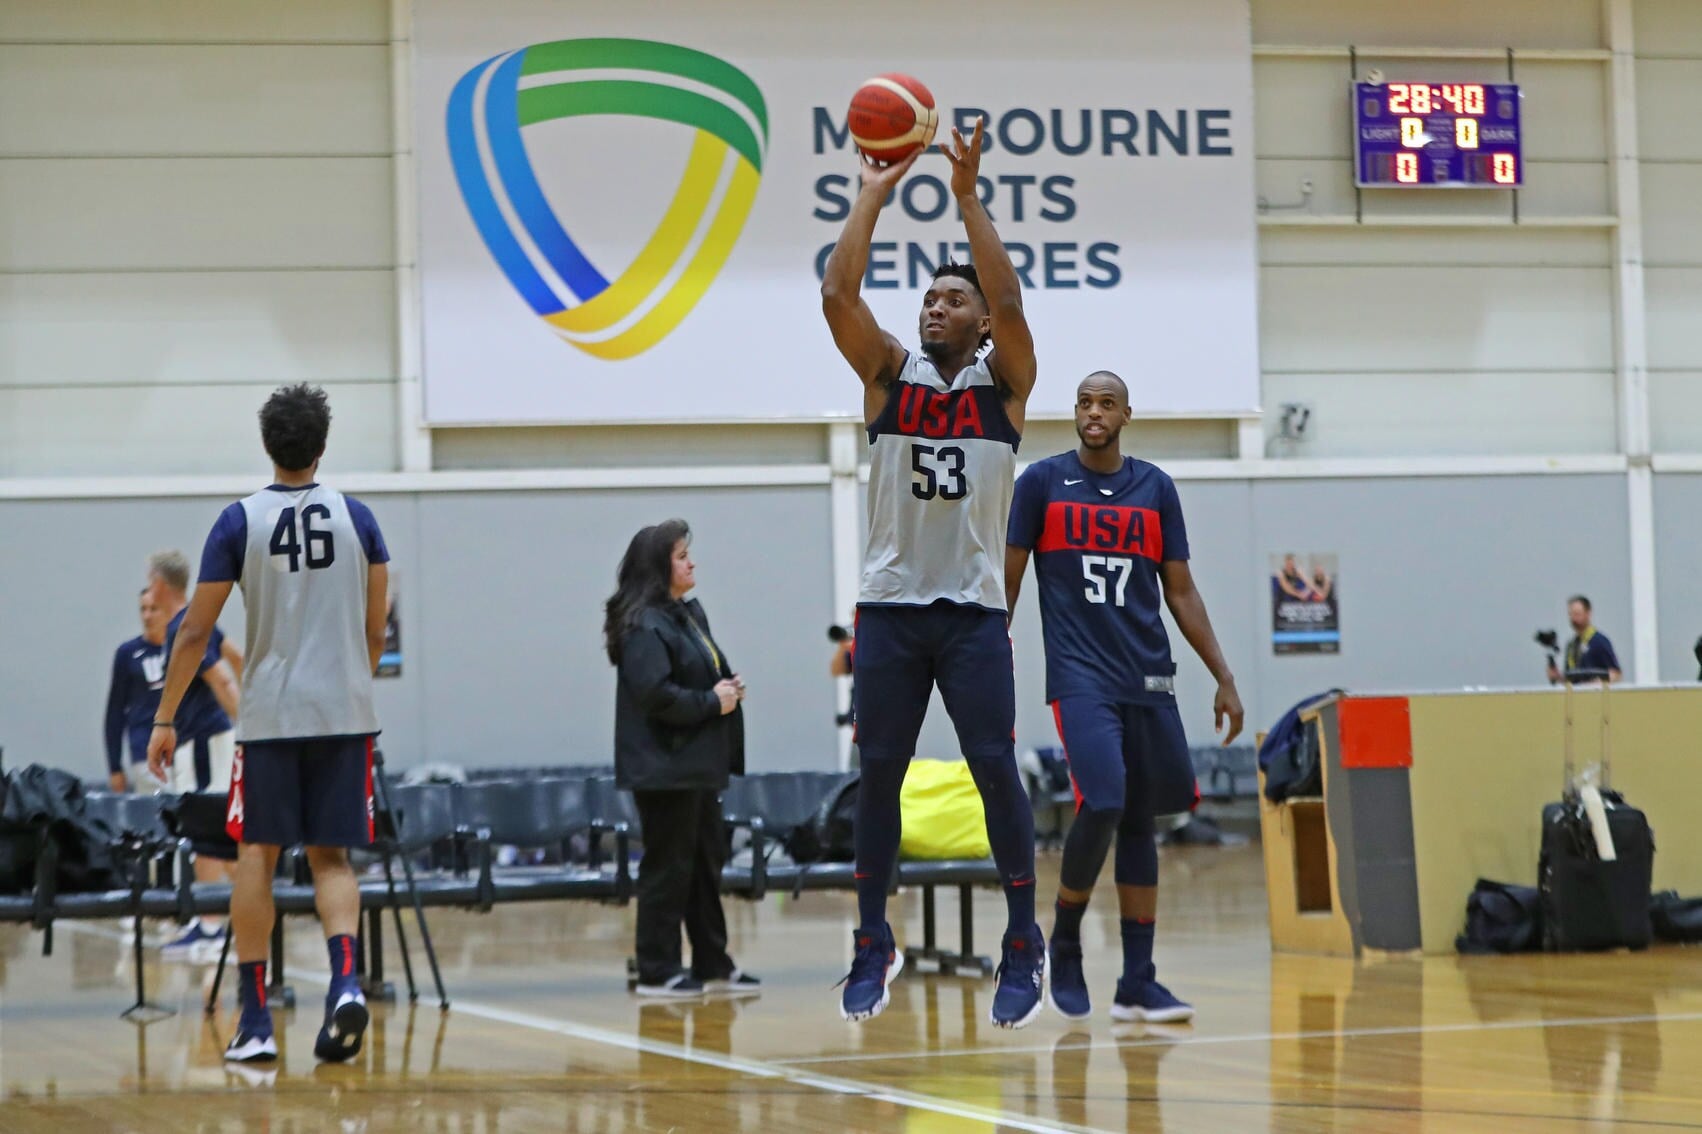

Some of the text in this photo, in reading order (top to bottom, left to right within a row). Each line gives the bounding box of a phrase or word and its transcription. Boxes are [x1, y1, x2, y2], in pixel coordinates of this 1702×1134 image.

[1388, 83, 1486, 115] 28:40
[813, 106, 1234, 156] MBOURNE
[1400, 117, 1424, 148] 0
[1455, 118, 1479, 149] 0
[1396, 153, 1515, 184] 0 0
[897, 385, 984, 437] USA
[911, 443, 967, 500] 53
[269, 503, 335, 573] 46
[1064, 505, 1145, 551] USA
[1081, 555, 1133, 607] 57
